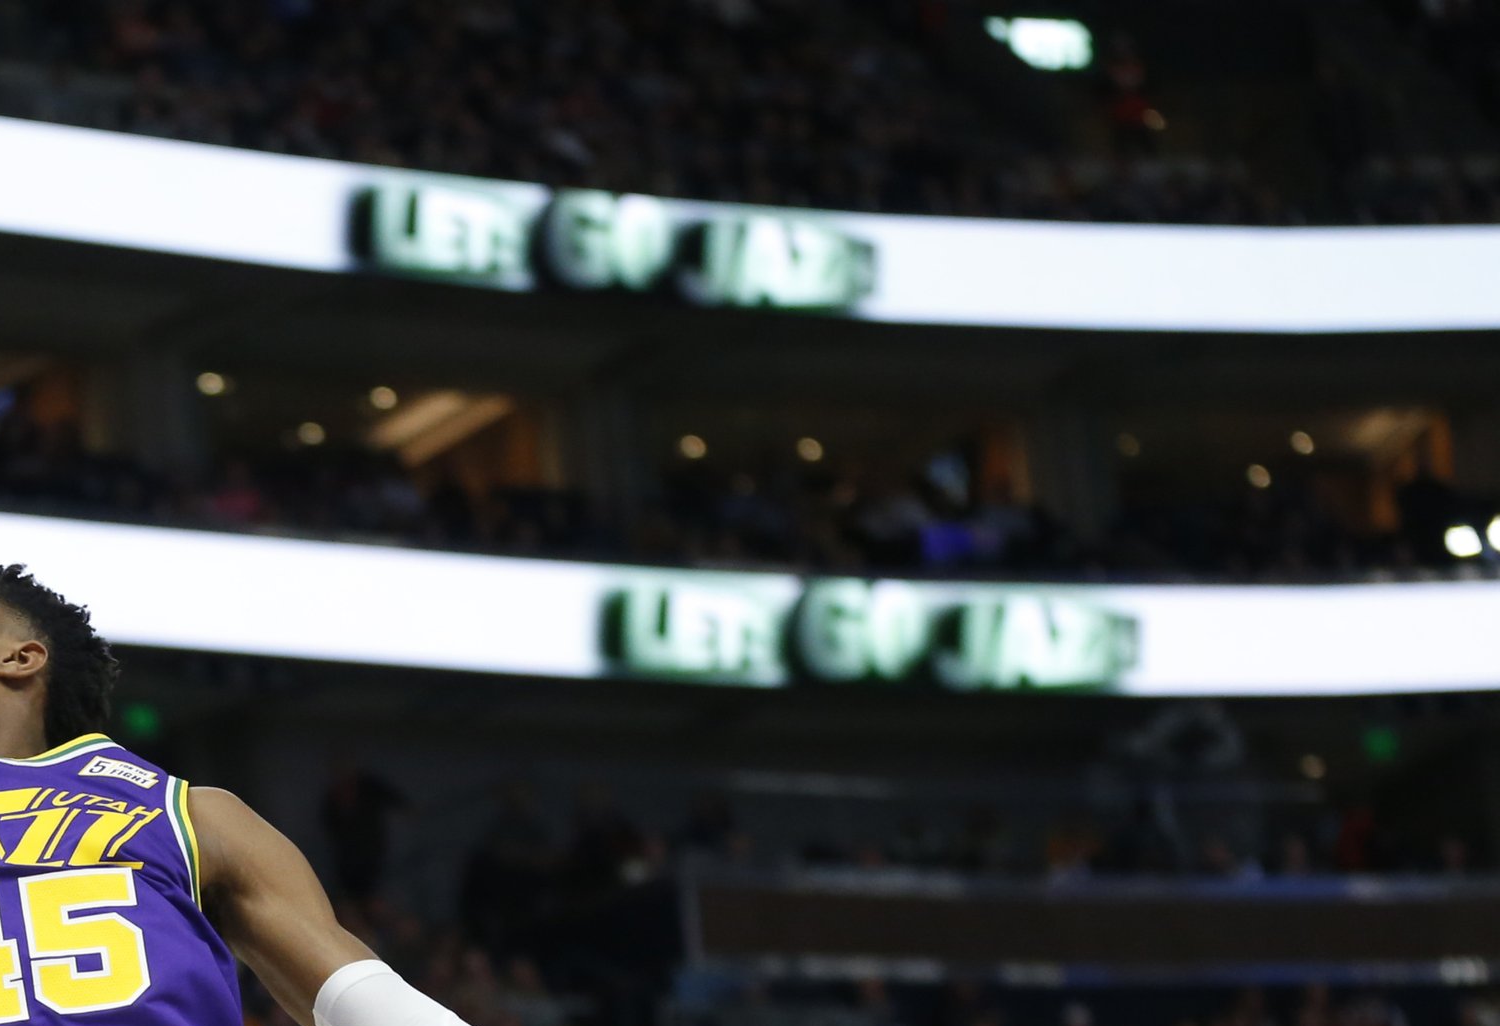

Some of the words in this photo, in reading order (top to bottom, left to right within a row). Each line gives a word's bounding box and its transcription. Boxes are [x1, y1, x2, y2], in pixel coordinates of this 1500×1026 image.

[88, 760, 112, 774] 5
[109, 768, 149, 785] FIGHT
[51, 790, 164, 821] UTAH
